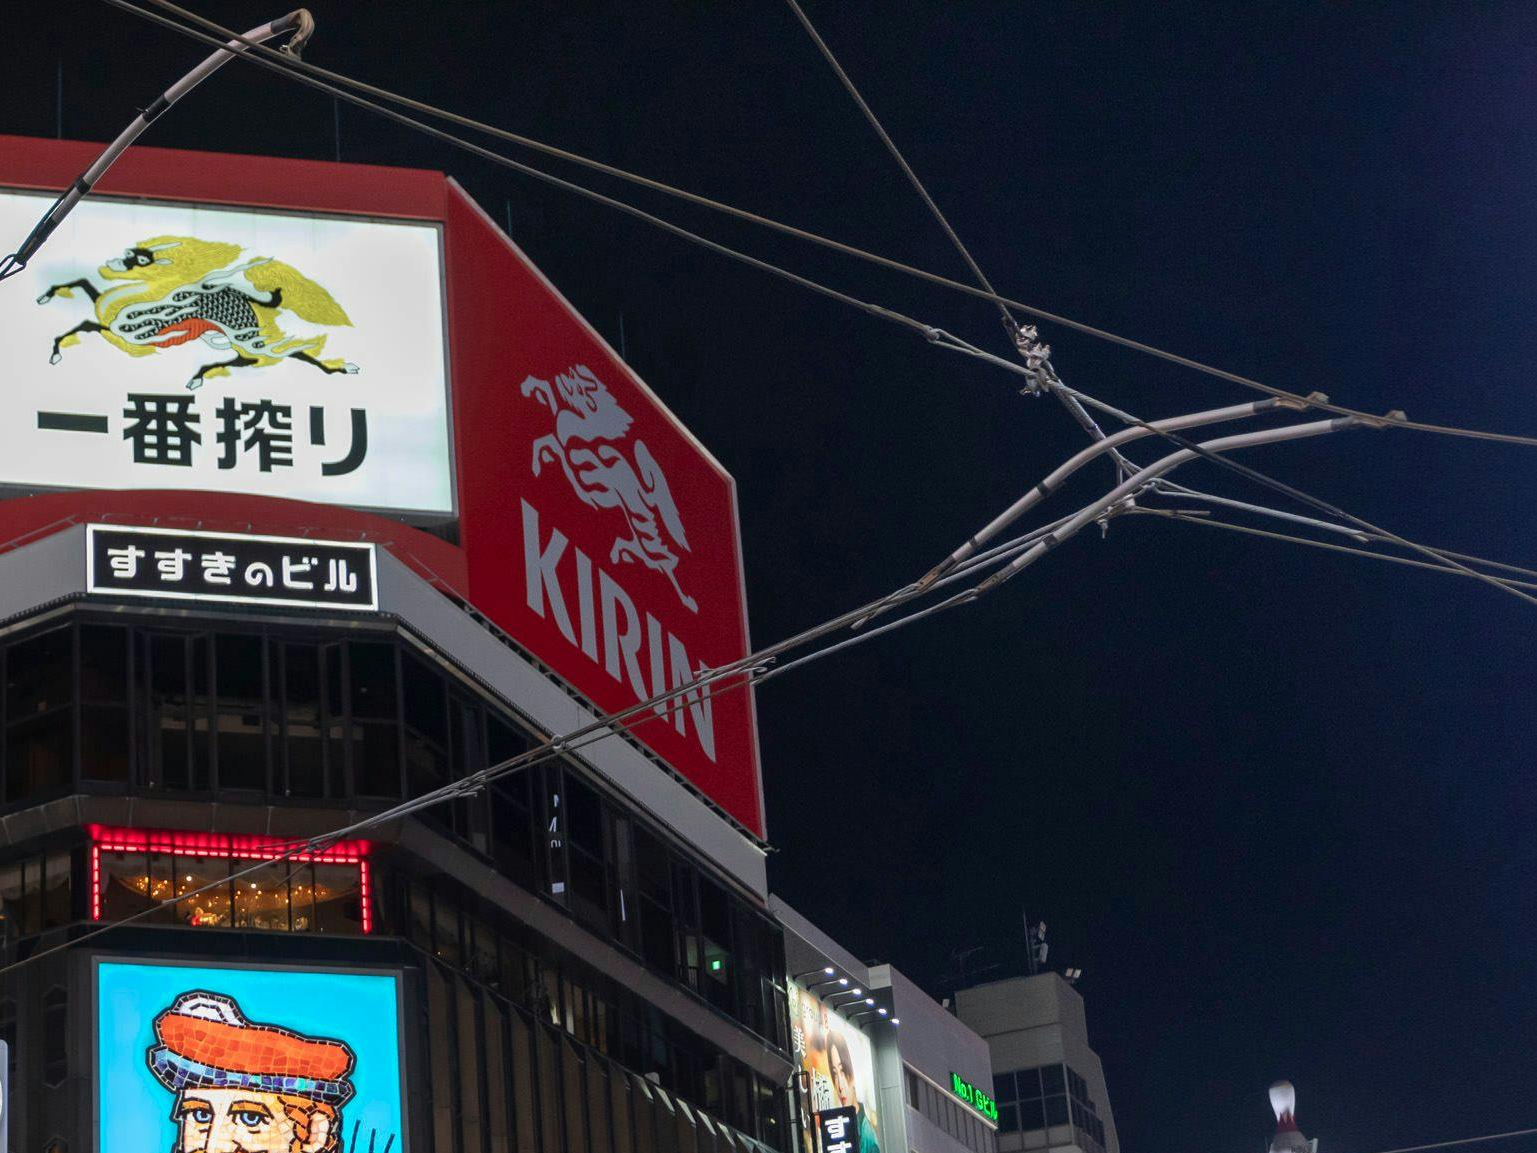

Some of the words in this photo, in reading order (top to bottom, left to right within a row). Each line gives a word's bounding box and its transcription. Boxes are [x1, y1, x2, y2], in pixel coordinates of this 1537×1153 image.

[37, 394, 368, 478] 一番搾り
[106, 545, 359, 596] すすきのビル
[520, 497, 716, 764] KIRIN
